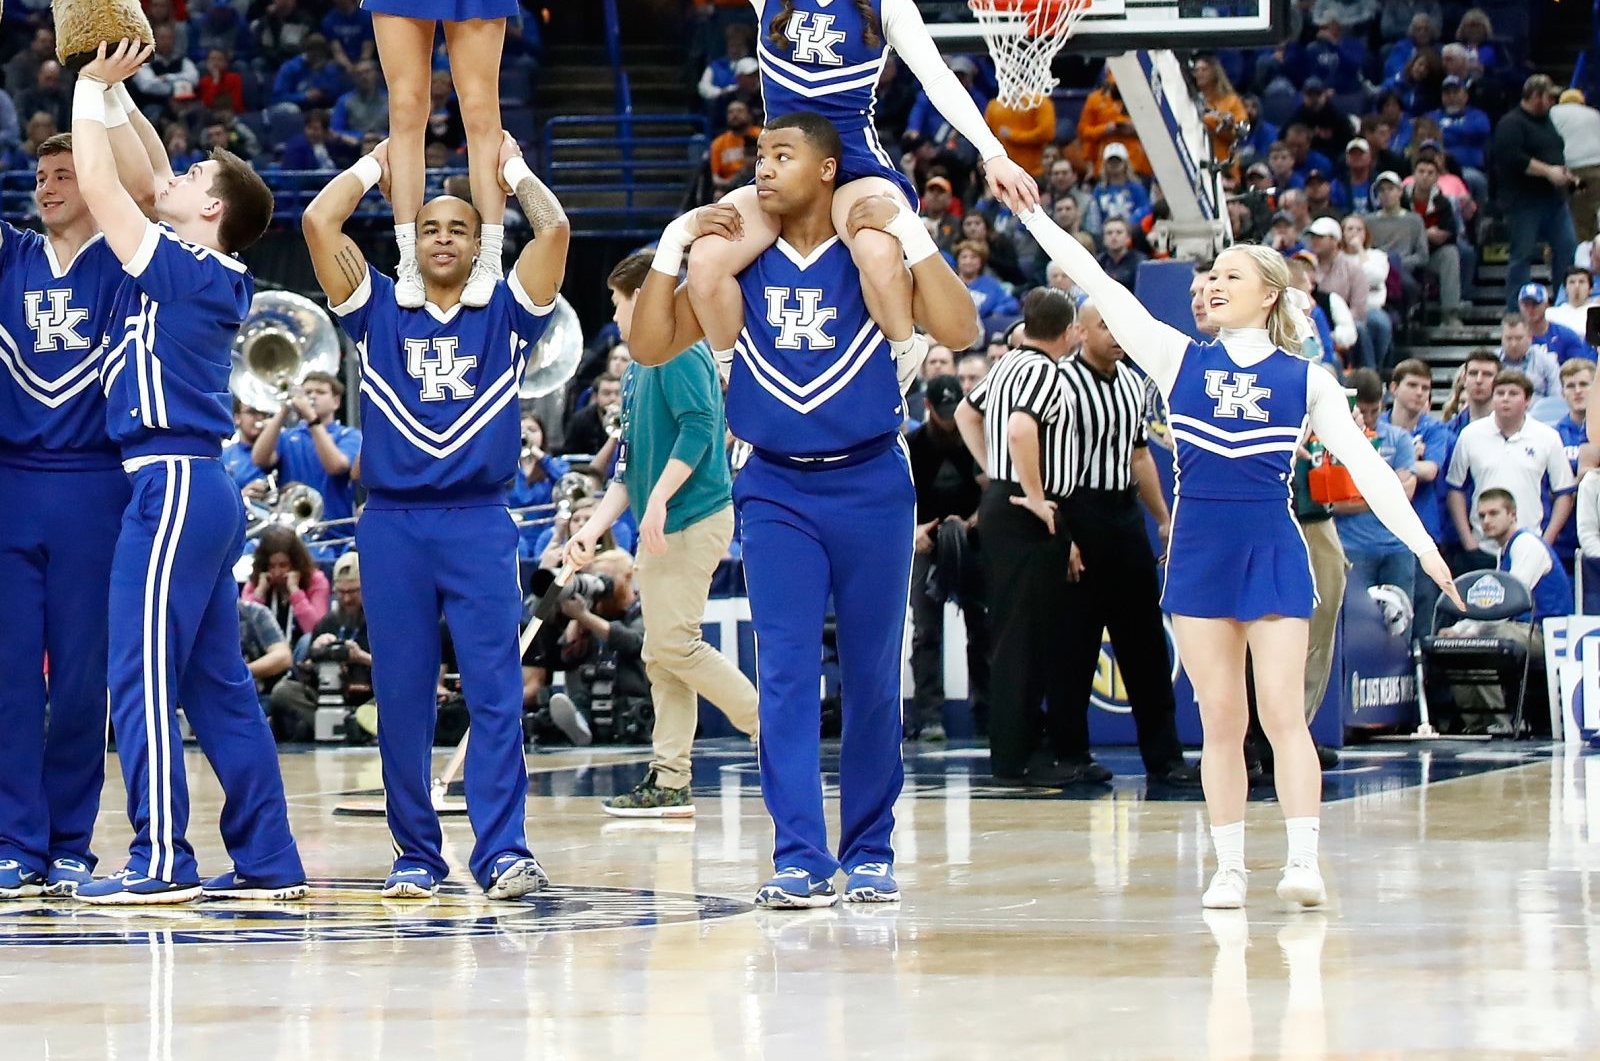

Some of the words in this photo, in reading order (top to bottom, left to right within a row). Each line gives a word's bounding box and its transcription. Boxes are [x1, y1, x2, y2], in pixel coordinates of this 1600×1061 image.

[784, 10, 847, 66] UK
[24, 289, 90, 353] UK
[765, 287, 838, 351] UK
[405, 337, 478, 402] UK
[1205, 370, 1272, 423] UK
